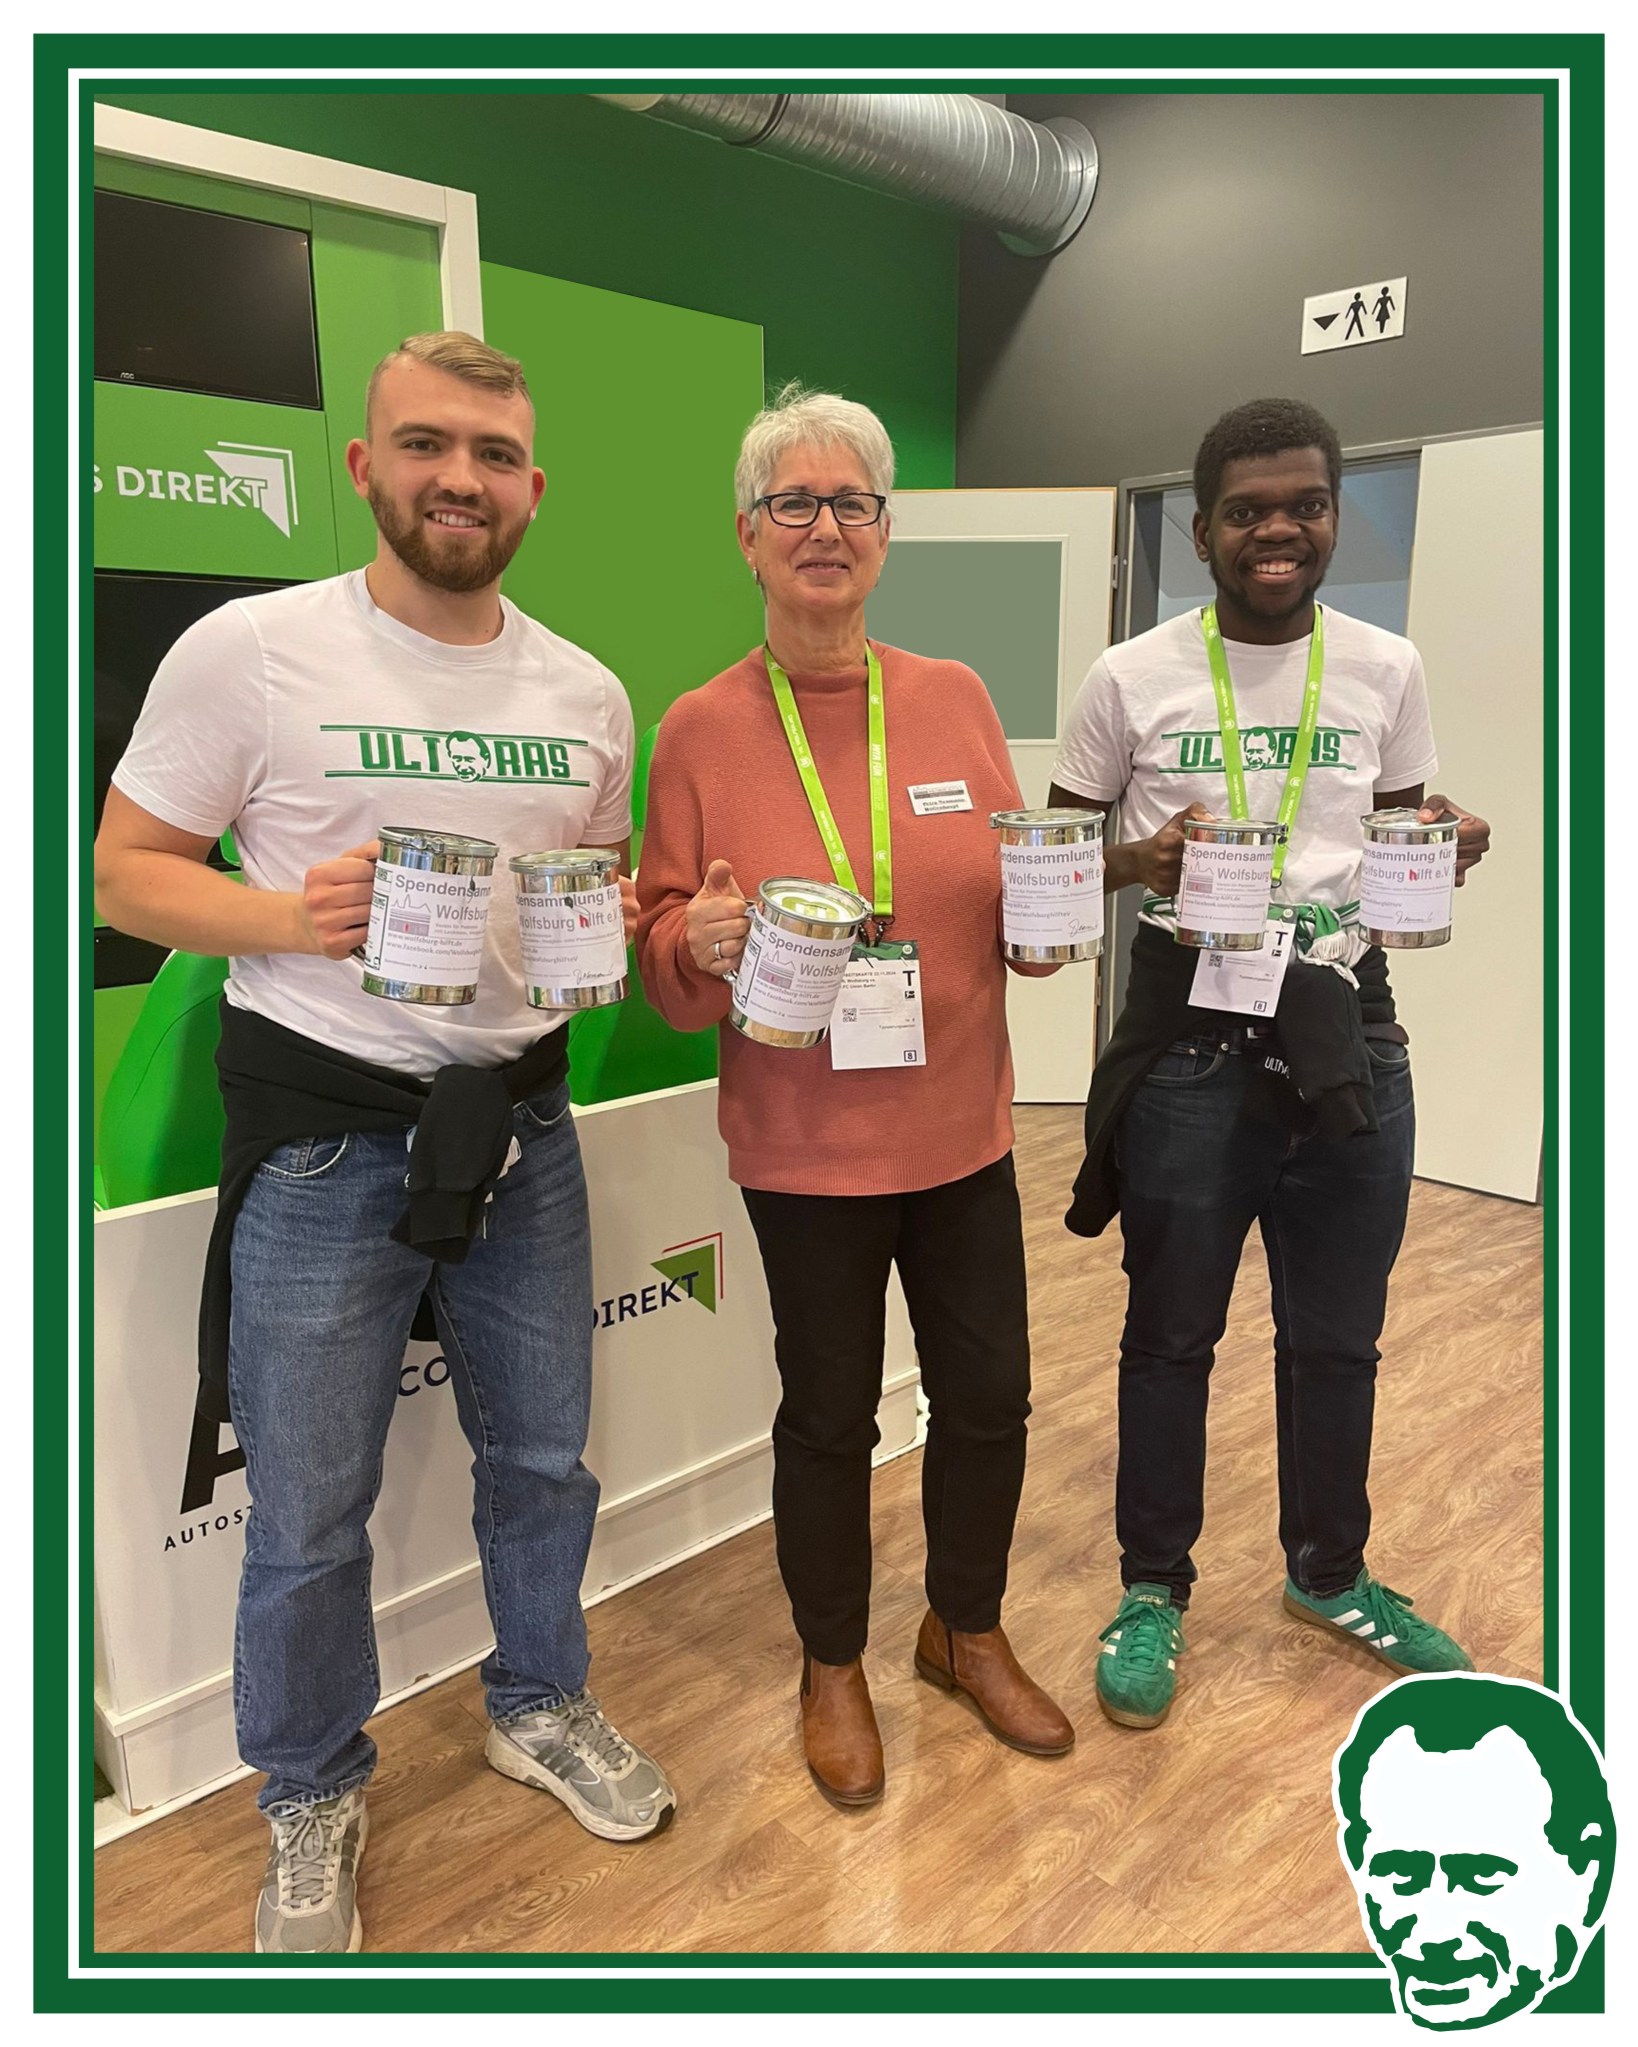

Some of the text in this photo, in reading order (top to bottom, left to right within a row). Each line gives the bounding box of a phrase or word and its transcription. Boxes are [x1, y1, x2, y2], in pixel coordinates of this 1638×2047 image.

[116, 465, 266, 509] DIREKT
[359, 732, 571, 779] ULTRAS
[1439, 848, 1452, 860] für
[1007, 871, 1070, 888] Wolfsburg
[1409, 868, 1432, 882] hilft
[1275, 931, 1289, 946] T
[902, 970, 916, 987] T
